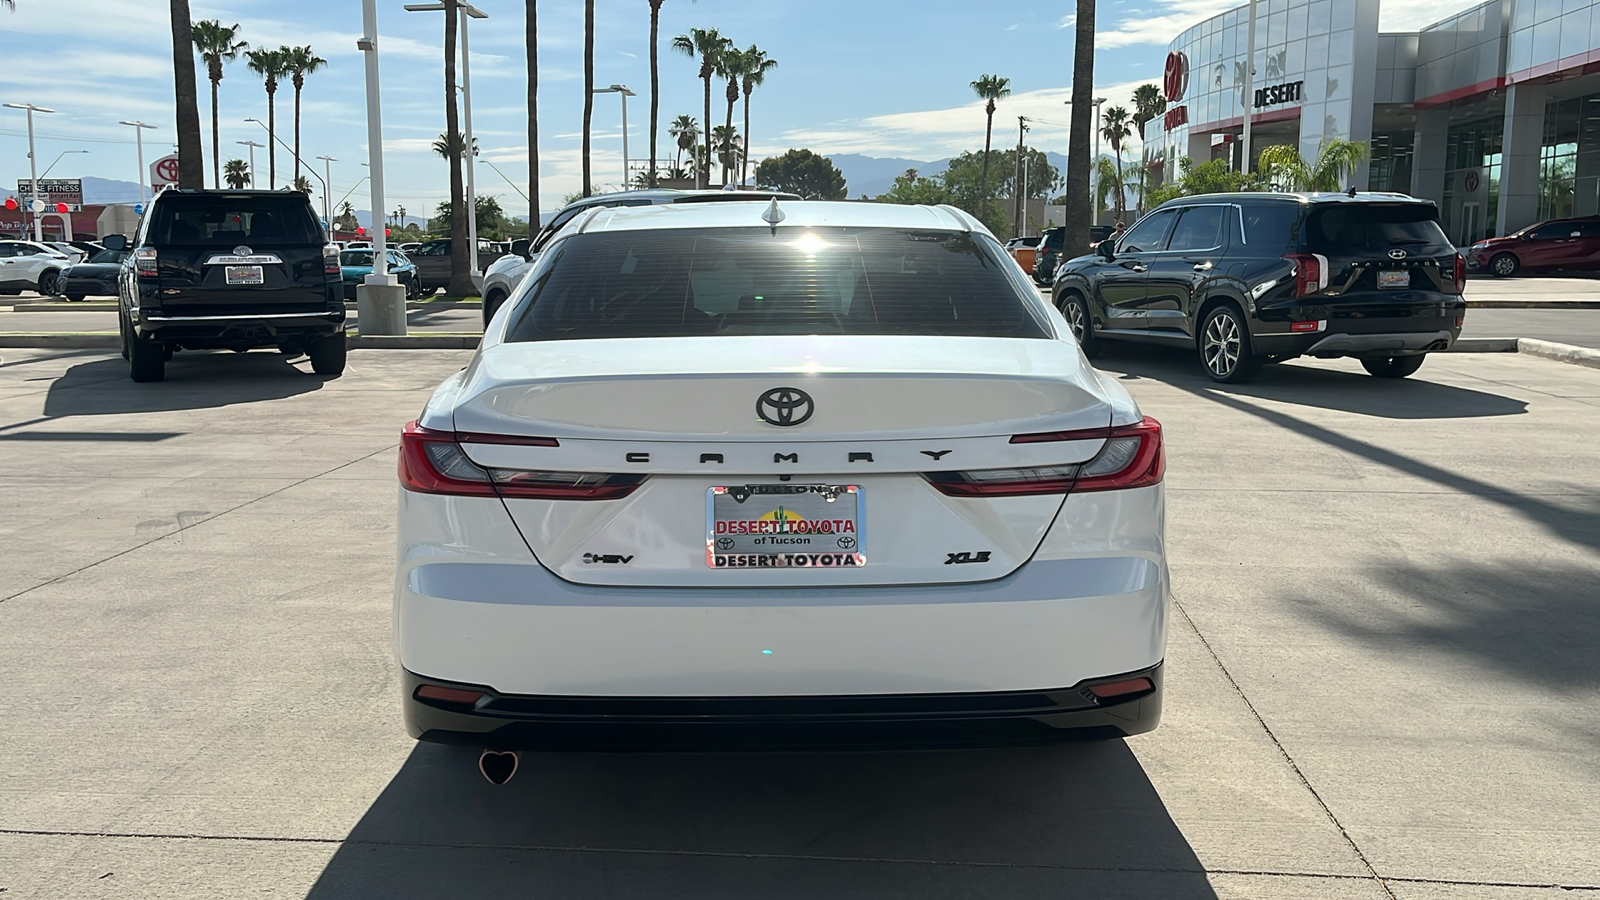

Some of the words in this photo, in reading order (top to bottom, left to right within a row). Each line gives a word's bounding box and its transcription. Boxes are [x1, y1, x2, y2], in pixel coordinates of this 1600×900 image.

[1255, 81, 1303, 108] DESERT
[626, 450, 953, 463] CAMRY
[716, 520, 780, 534] DESERT
[786, 519, 856, 533] TOYOTA
[754, 536, 766, 545] of
[768, 536, 811, 545] Tucson
[715, 555, 778, 567] DESERT
[785, 554, 856, 566] TOYOTA
[944, 551, 992, 565] XLE
